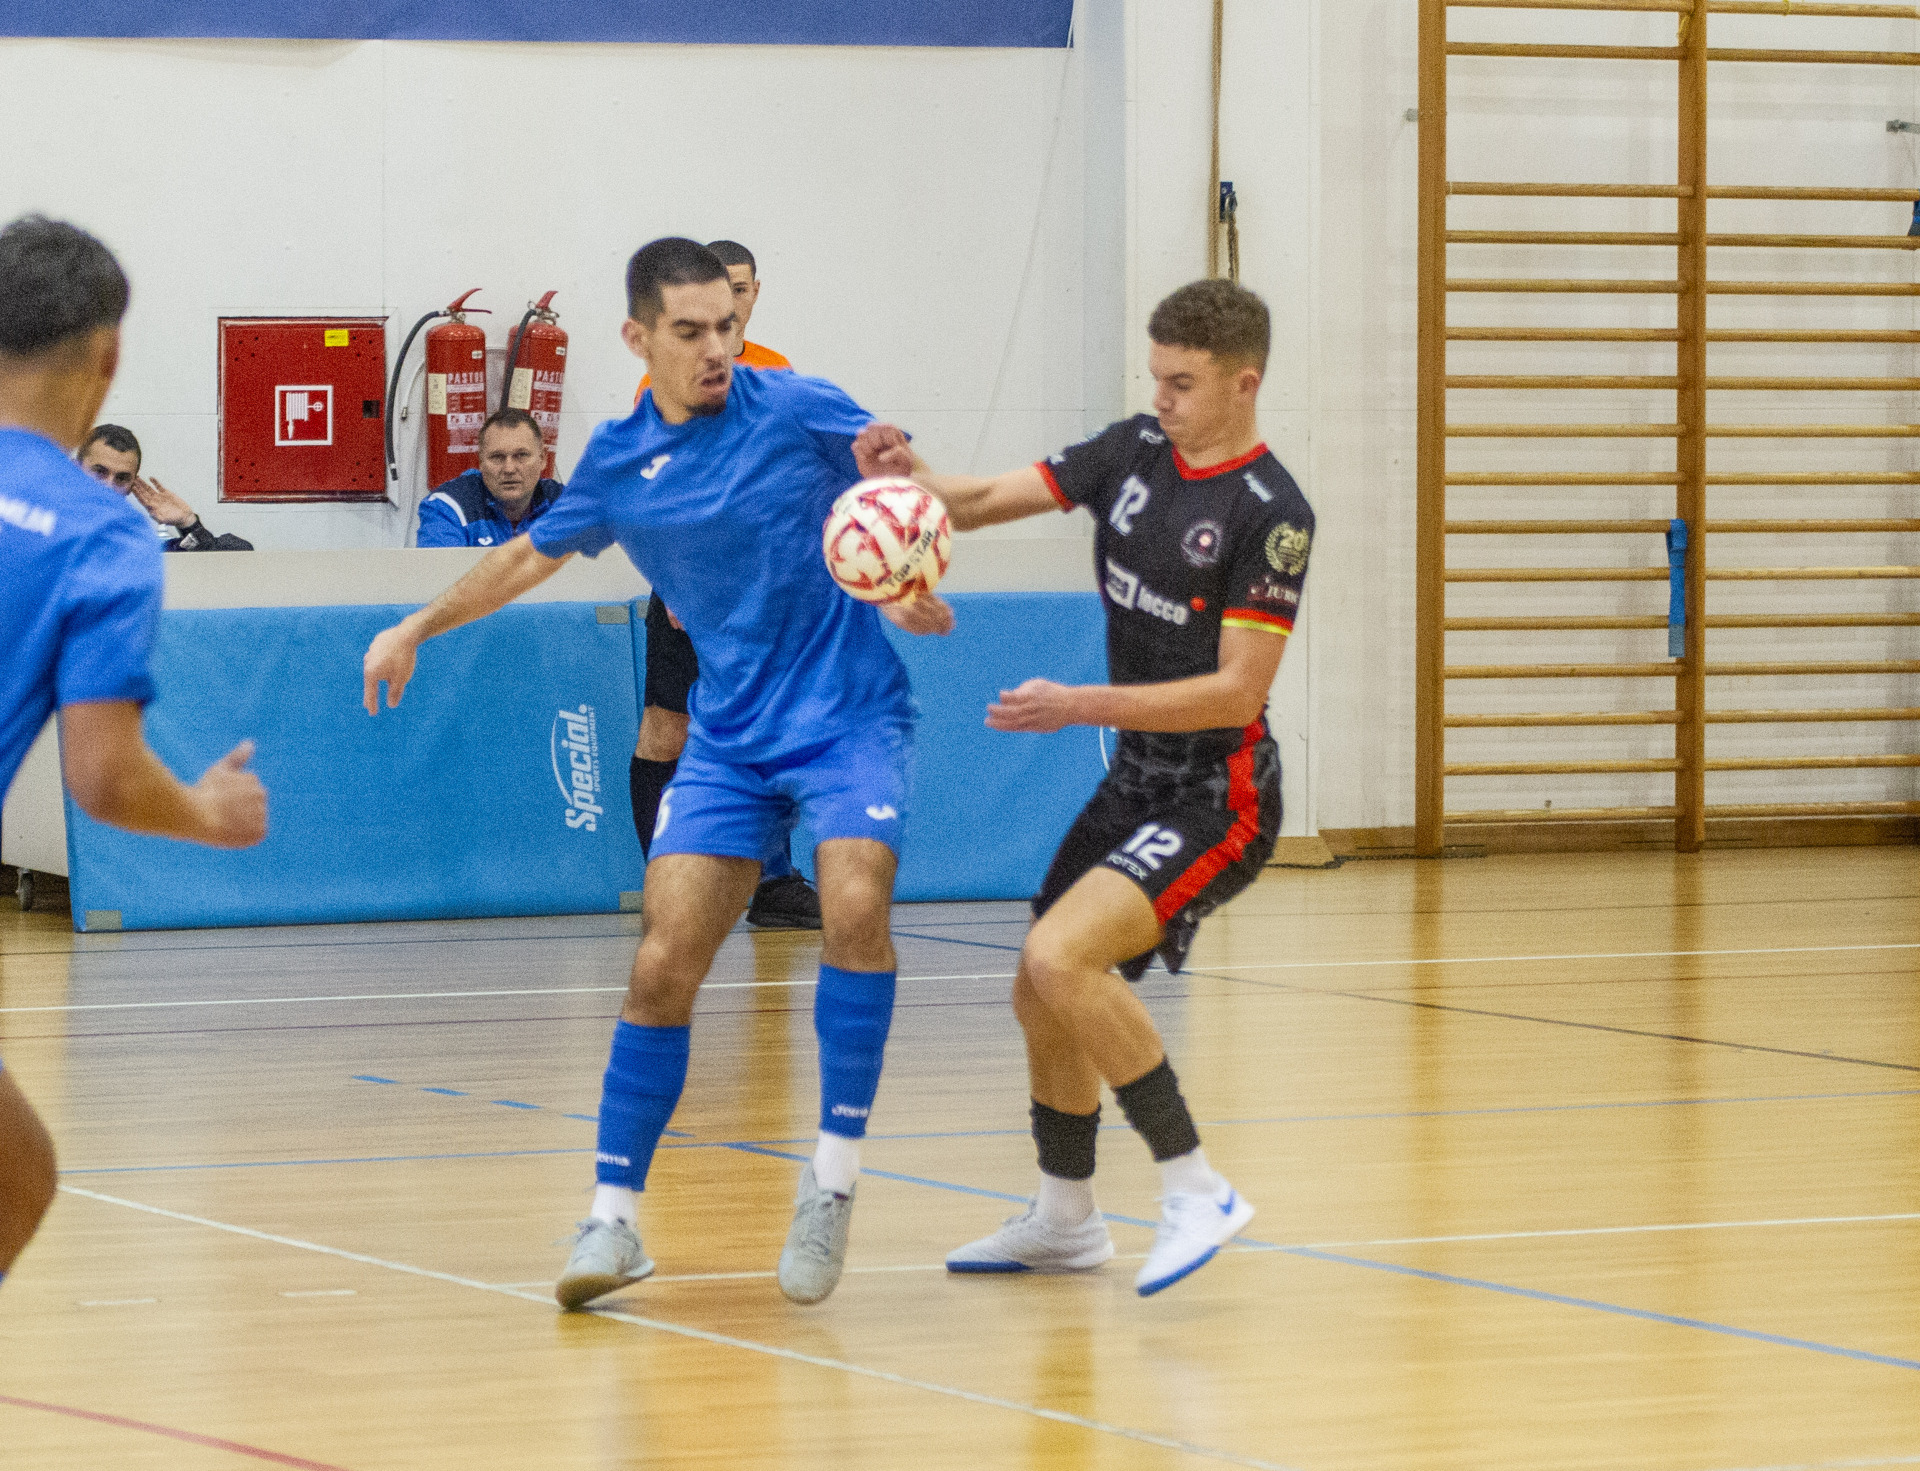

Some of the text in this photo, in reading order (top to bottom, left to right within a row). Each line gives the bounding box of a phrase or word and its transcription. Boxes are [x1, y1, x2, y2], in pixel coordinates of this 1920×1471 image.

[587, 705, 601, 793] SPORTS EQUIPMENT
[1121, 822, 1182, 871] 12
